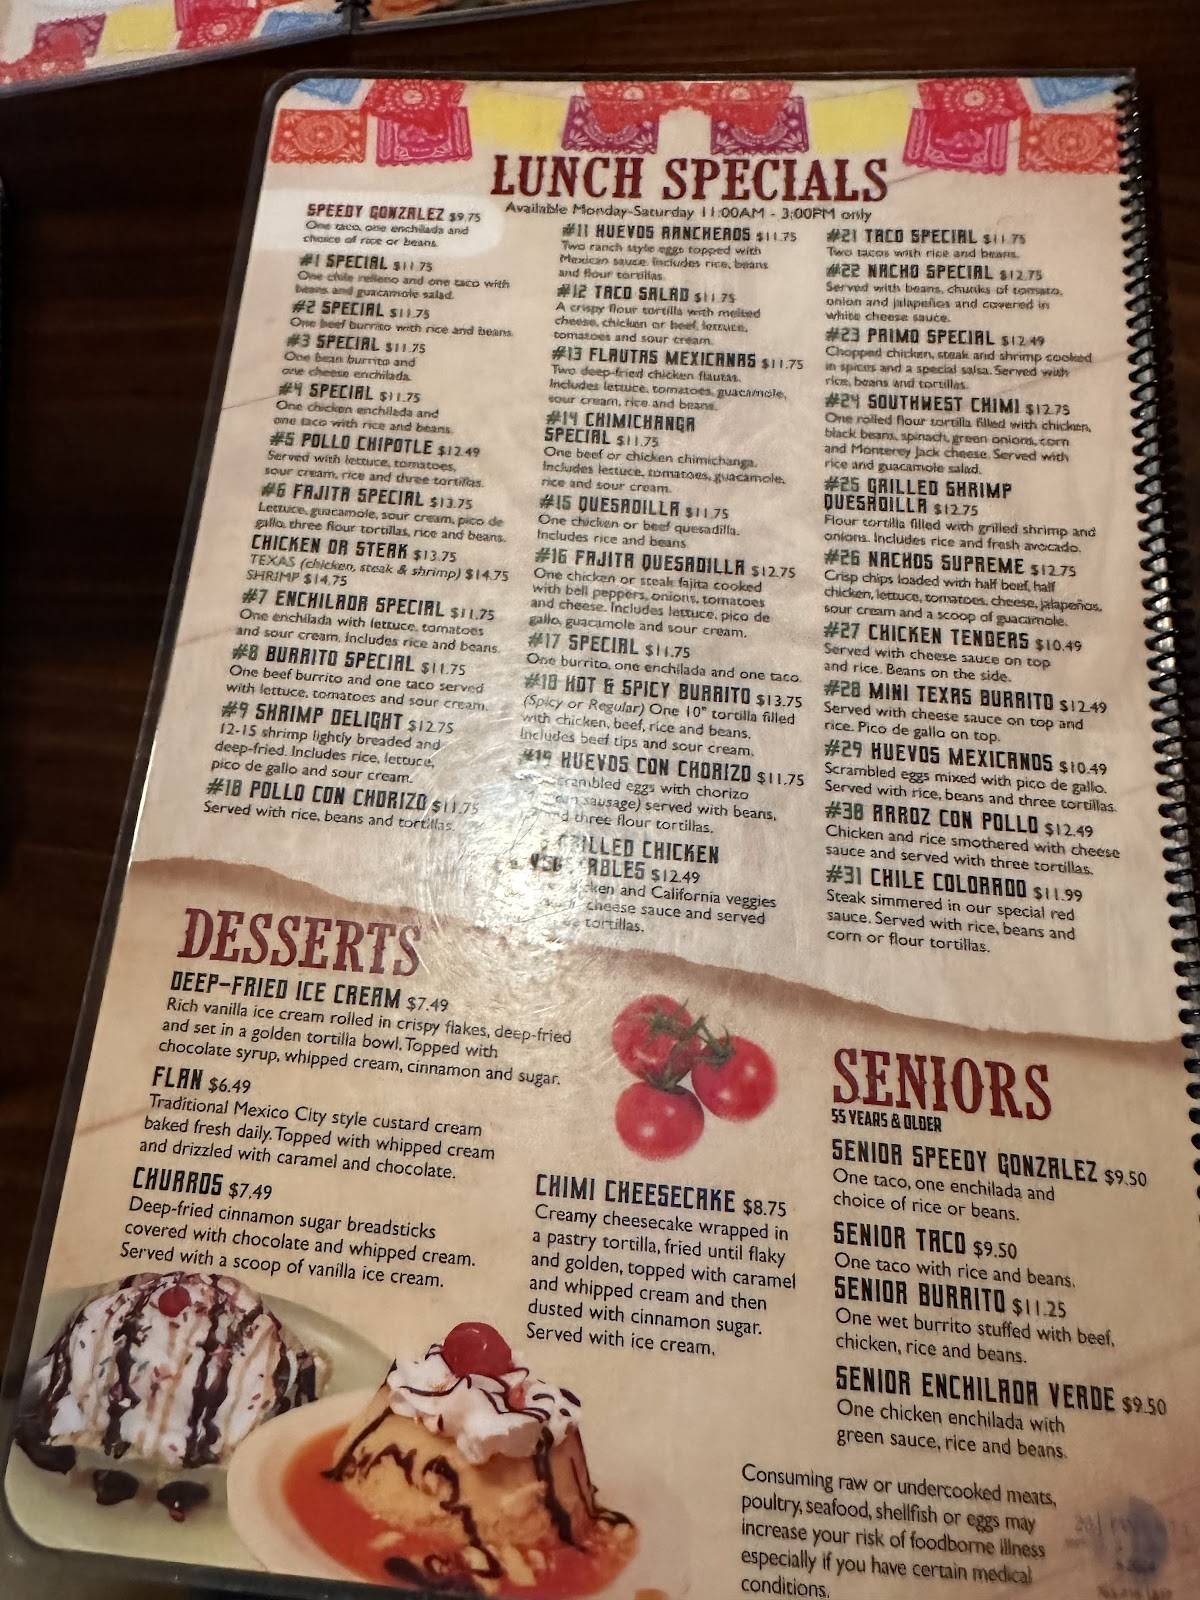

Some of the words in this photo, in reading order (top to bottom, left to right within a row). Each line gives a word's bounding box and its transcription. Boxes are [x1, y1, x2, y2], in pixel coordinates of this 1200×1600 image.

[490, 154, 644, 199] LUNCH
[663, 157, 889, 203] SPECIALS
[306, 203, 364, 218] SPEEDY
[368, 205, 445, 221] GONZALEZ
[448, 212, 481, 223] $9.75
[505, 201, 567, 215] Available
[572, 204, 695, 221] Monday-Saturday
[701, 206, 765, 219] 11:00AM
[780, 206, 835, 221] 3:00PM
[840, 209, 872, 223] only
[562, 222, 588, 237] #11
[595, 223, 654, 239] HUEVOS
[660, 225, 751, 241] RANCHEROS
[755, 231, 797, 242] $11.75
[826, 228, 857, 243] #21
[864, 228, 904, 244] TACO
[910, 228, 977, 244] SPECIAL
[983, 233, 1026, 244] $11.75
[556, 283, 588, 299] #12
[594, 284, 632, 300] TACO
[638, 286, 690, 302] SALAD
[694, 292, 736, 304] $11.75
[286, 333, 311, 348] #3
[315, 333, 380, 351] SPECIAL
[385, 341, 426, 354] $11.75
[551, 345, 583, 361] #13
[588, 346, 658, 365] FLAUTAS
[664, 349, 756, 368] MEXICANAS
[761, 357, 803, 370] $11.75
[824, 391, 860, 409] #24
[866, 393, 963, 412] SOUTHWEST
[970, 396, 1020, 414] CHIMI
[1025, 403, 1070, 416] $12.75
[269, 431, 295, 446] #5
[300, 432, 351, 450] POLLO
[354, 435, 433, 455] CHIPOTLE
[436, 445, 480, 457] $12.49
[260, 481, 286, 498] #6
[292, 483, 351, 502] FAJITA
[356, 487, 424, 507] SPECIAL
[428, 496, 473, 510] $13.75
[251, 533, 321, 553] CHICKEN
[327, 538, 348, 556] OR
[355, 540, 408, 559] STEAK
[413, 549, 456, 563] $13.75
[534, 547, 568, 564] #16
[574, 549, 634, 568] FAJITA
[641, 553, 745, 575] QUESADILLA
[751, 565, 796, 578] $12.75
[250, 553, 296, 568] TEXAS
[359, 562, 393, 574] steak
[396, 564, 408, 576] &
[410, 560, 461, 581] shrimp)
[464, 567, 509, 582] $14.75
[527, 631, 561, 649] #17
[568, 633, 639, 655] SPECIAL
[645, 643, 690, 659] $11.75
[823, 621, 860, 640] #27
[868, 623, 942, 644] CHICKEN
[949, 628, 1029, 649] TENDERS
[1035, 638, 1082, 652] $10.49
[525, 652, 556, 666] One
[614, 662, 640, 672] one
[643, 662, 706, 676] enchilada
[710, 666, 735, 678] and
[739, 670, 765, 680] one
[823, 641, 871, 657] Served
[874, 646, 905, 659] with
[909, 647, 957, 662] cheese
[961, 654, 999, 665] sauce
[1004, 656, 1022, 666] on
[1026, 657, 1051, 671] top
[823, 660, 848, 672] and
[884, 663, 926, 677] Beans
[930, 669, 949, 678] on
[952, 667, 975, 680] the
[979, 669, 1012, 683] side.
[221, 700, 249, 719] #9
[255, 702, 324, 724] SHRIMP
[330, 708, 404, 731] DELIGHT
[406, 719, 454, 734] $12.75
[210, 758, 241, 772] pico
[244, 760, 263, 772] de
[264, 762, 298, 777] gallo
[301, 764, 328, 777] and
[330, 768, 364, 780] sour
[366, 770, 414, 783] cream.
[825, 864, 861, 885] #31
[870, 867, 925, 890] CHILE
[932, 872, 1027, 898] COLORADO
[1033, 886, 1082, 902] $11.99
[177, 908, 423, 977] DESSERTS
[826, 930, 862, 942] corn
[866, 933, 885, 944] or
[888, 931, 925, 947] flour
[928, 937, 990, 953] tortillas.
[170, 970, 288, 999] DEEP-FRIED
[295, 980, 326, 1002] ICE
[333, 983, 401, 1009] CREAM
[406, 996, 449, 1012] $7.49
[151, 1065, 204, 1090] FLAN
[207, 1076, 251, 1094] $6.49
[833, 1048, 1051, 1121] SENIORS
[149, 1092, 229, 1114] Traditional
[233, 1100, 289, 1120] Mexico
[294, 1105, 327, 1127] City
[330, 1111, 367, 1129] style
[372, 1116, 430, 1132] custard
[434, 1122, 482, 1136] cream
[831, 1107, 846, 1124] 55
[848, 1109, 888, 1127] YEARS
[890, 1112, 901, 1129] &
[903, 1113, 942, 1132] OLDER
[831, 1138, 902, 1166] SENIOR
[912, 1145, 987, 1173] SPEEDY
[997, 1152, 1098, 1183] GONZALEZ
[1104, 1169, 1147, 1187] $9.50
[132, 1166, 224, 1196] CHURROS
[228, 1181, 272, 1200] $7.49
[535, 1173, 595, 1200] CHIMI
[604, 1179, 735, 1213] CHEESECAKE
[742, 1198, 786, 1218] $8.75
[833, 1220, 906, 1249] SENIOR
[915, 1227, 966, 1255] TACO
[972, 1240, 1017, 1259] $9.50
[834, 1275, 907, 1304] SENIOR
[918, 1282, 1006, 1313] BURRITO
[1012, 1297, 1066, 1318] $11.25
[526, 1321, 583, 1343] Served
[588, 1329, 624, 1347] with
[631, 1332, 654, 1350] ice
[659, 1339, 715, 1356] cream.
[835, 1364, 911, 1396] SENIOR
[921, 1372, 1038, 1406] ENCHILADA
[1048, 1382, 1115, 1412] VERDE
[1121, 1396, 1166, 1416] $9.50
[741, 1464, 834, 1494] Consuming
[838, 1476, 868, 1493] raw
[872, 1479, 892, 1494] or
[897, 1477, 1001, 1502] undercooked
[1006, 1489, 1056, 1508] meats,
